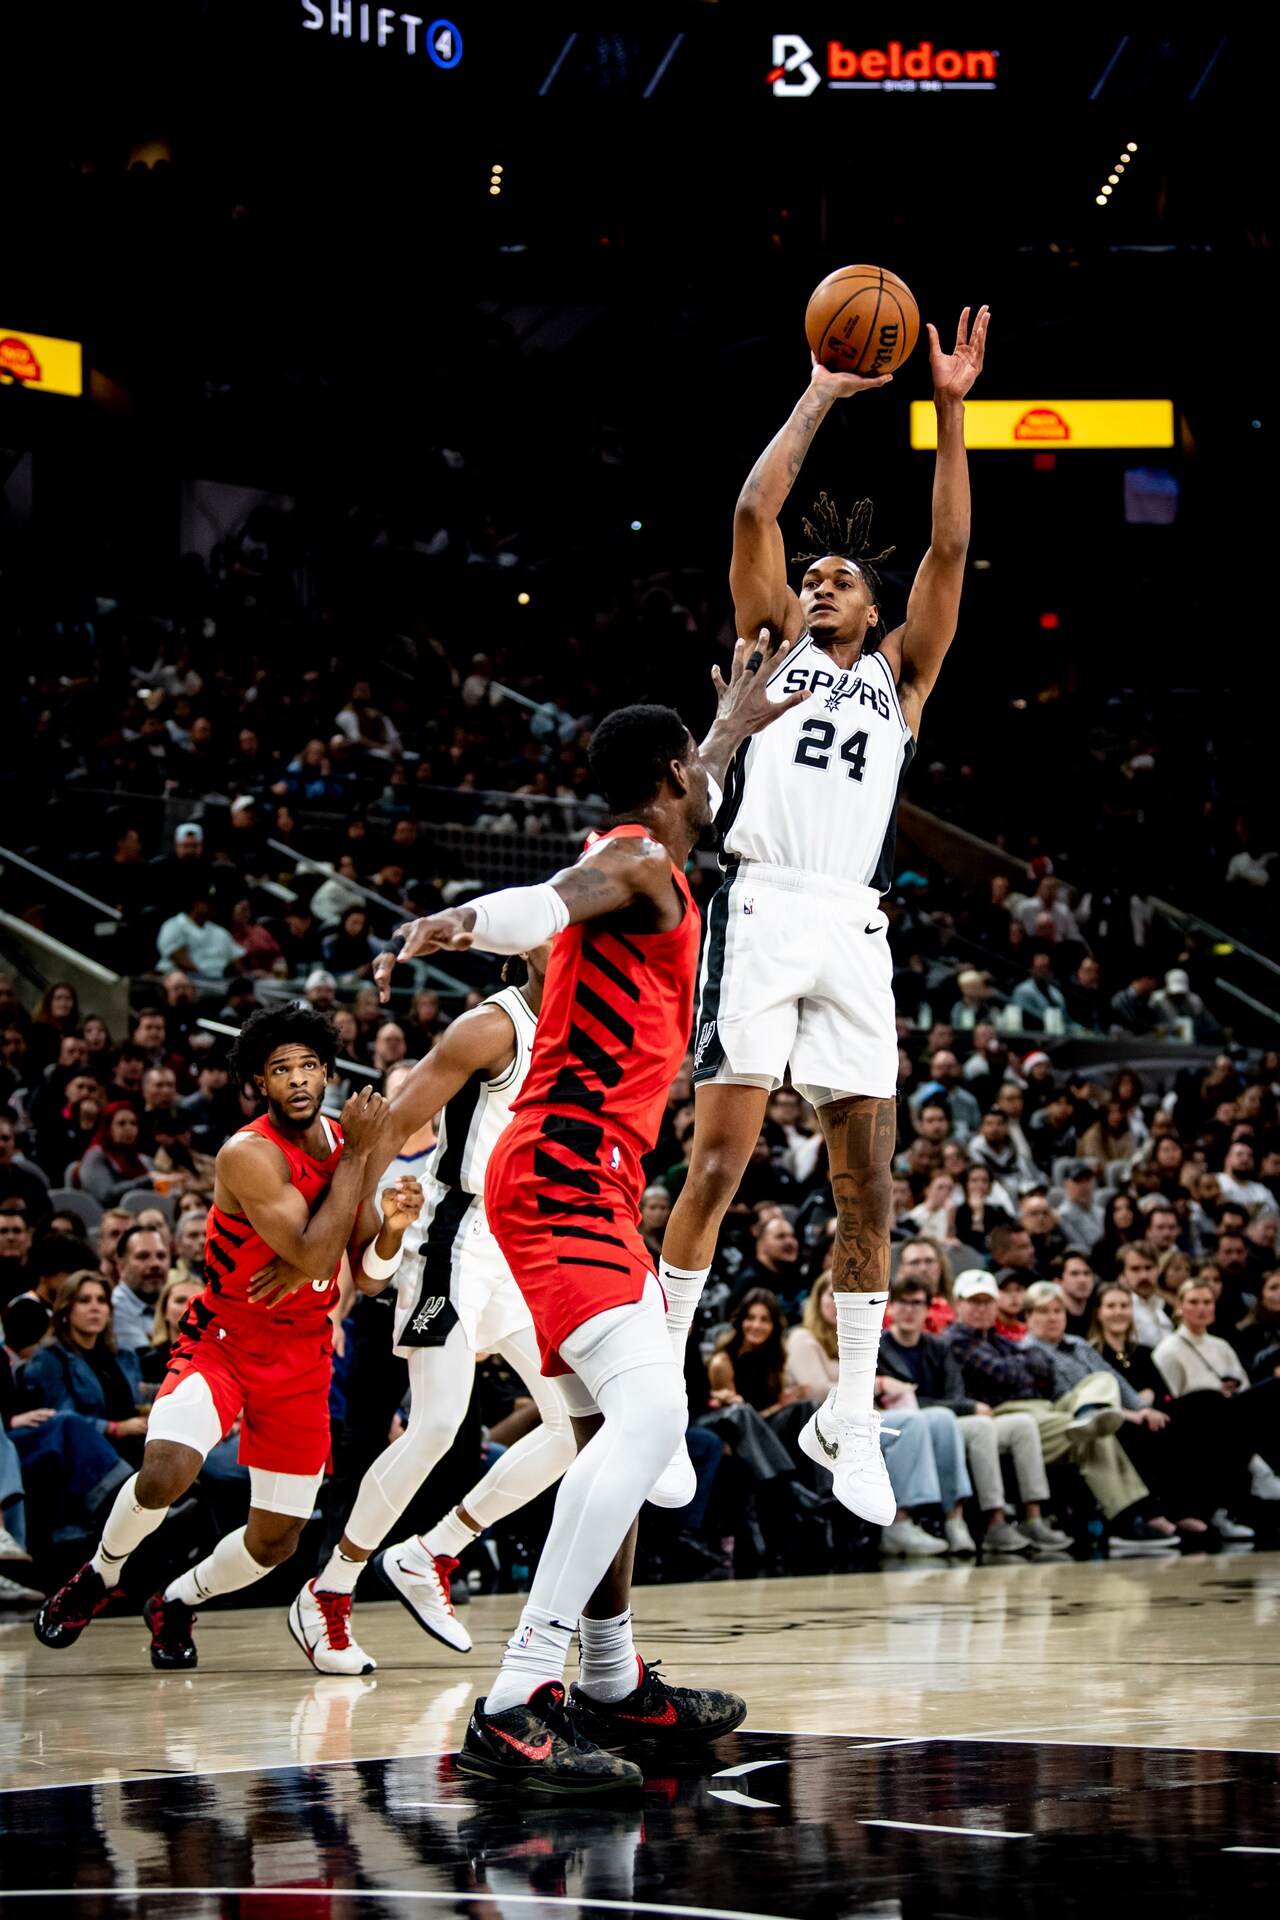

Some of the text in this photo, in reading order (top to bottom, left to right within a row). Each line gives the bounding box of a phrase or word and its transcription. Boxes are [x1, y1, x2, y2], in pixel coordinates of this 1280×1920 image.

[827, 40, 998, 79] beldon
[783, 667, 890, 721] SPURS
[793, 717, 870, 785] 24
